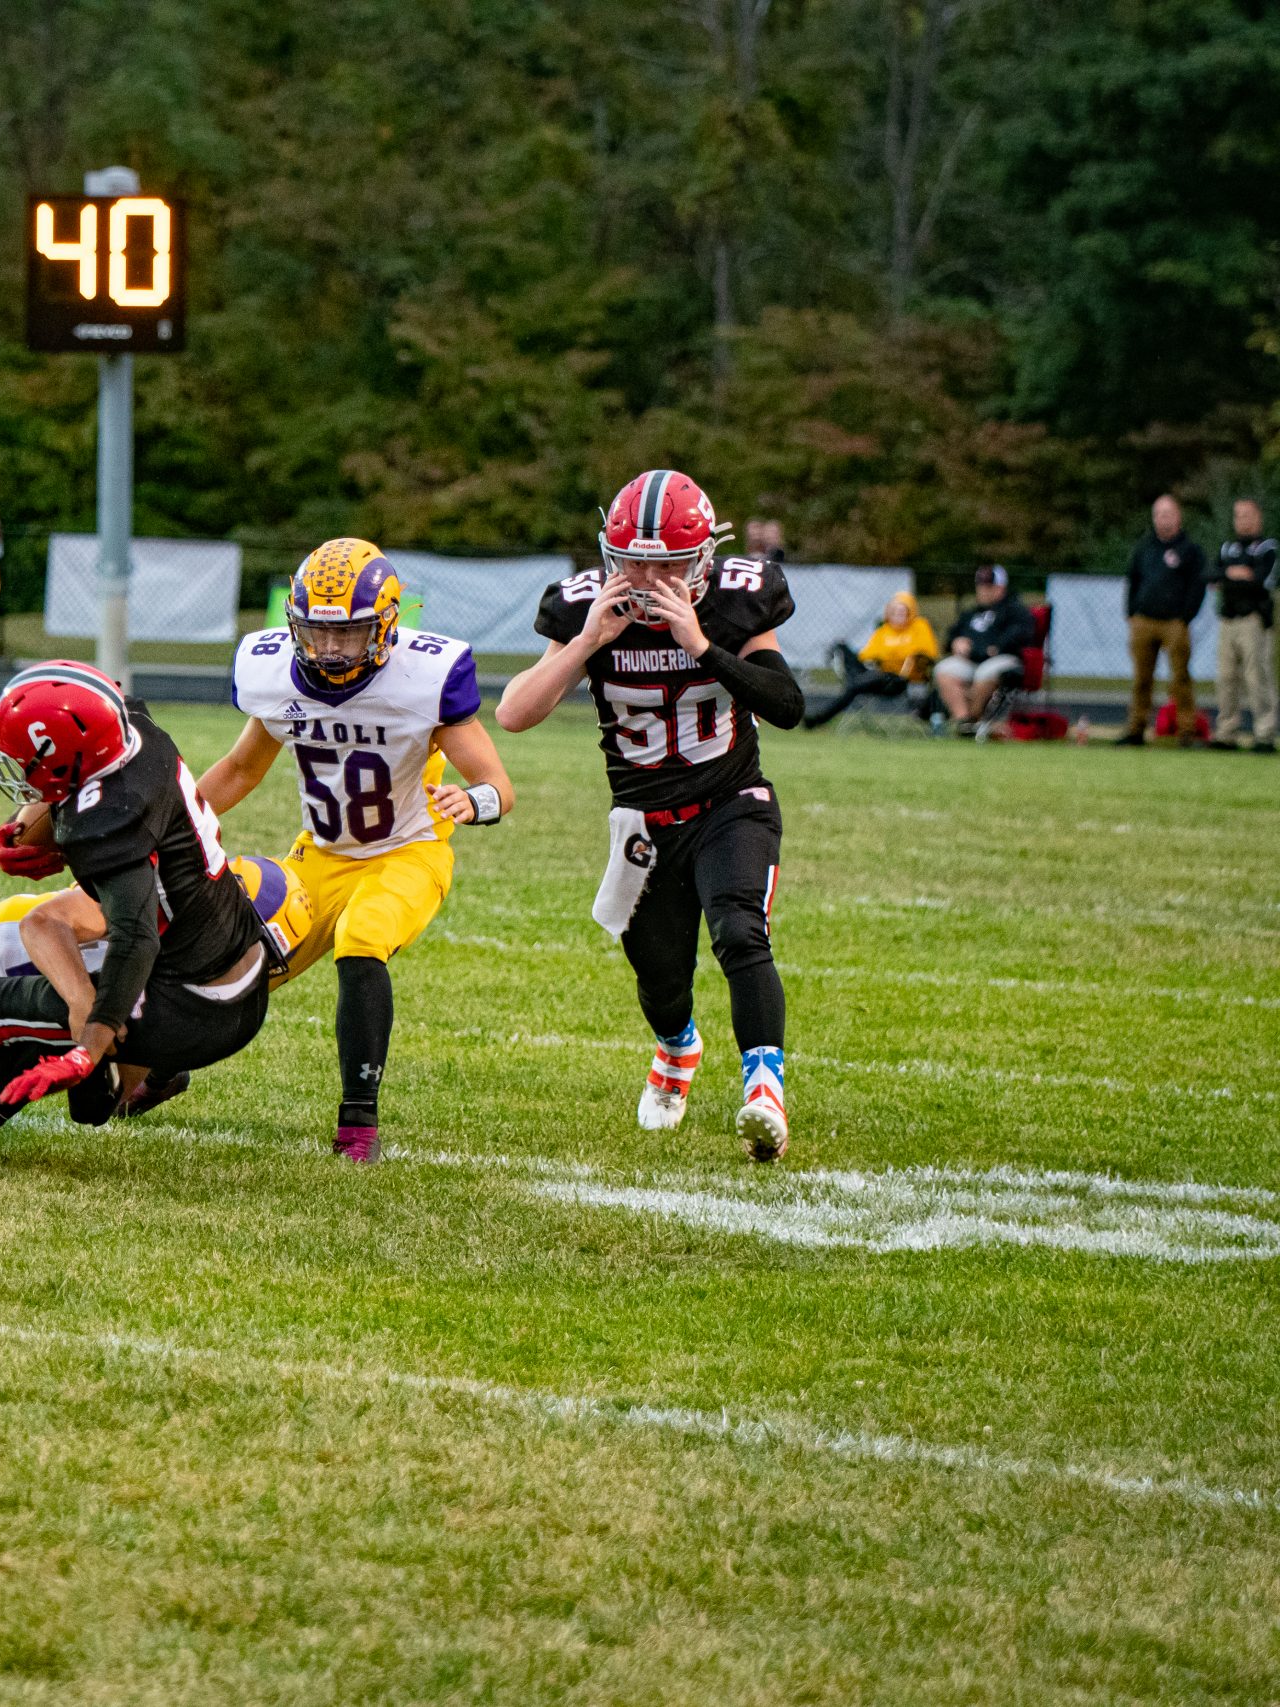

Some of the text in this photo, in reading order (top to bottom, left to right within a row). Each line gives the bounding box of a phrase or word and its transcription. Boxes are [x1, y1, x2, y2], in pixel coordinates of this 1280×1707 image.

[35, 197, 171, 307] 40
[632, 541, 662, 550] Riddell
[720, 557, 763, 592] 50
[313, 606, 343, 616] Riddell
[251, 631, 290, 657] 58
[408, 634, 450, 656] 58
[282, 711, 307, 720] adidas
[602, 679, 736, 769] 50
[286, 718, 388, 746] PAOLI
[294, 742, 396, 845] 58
